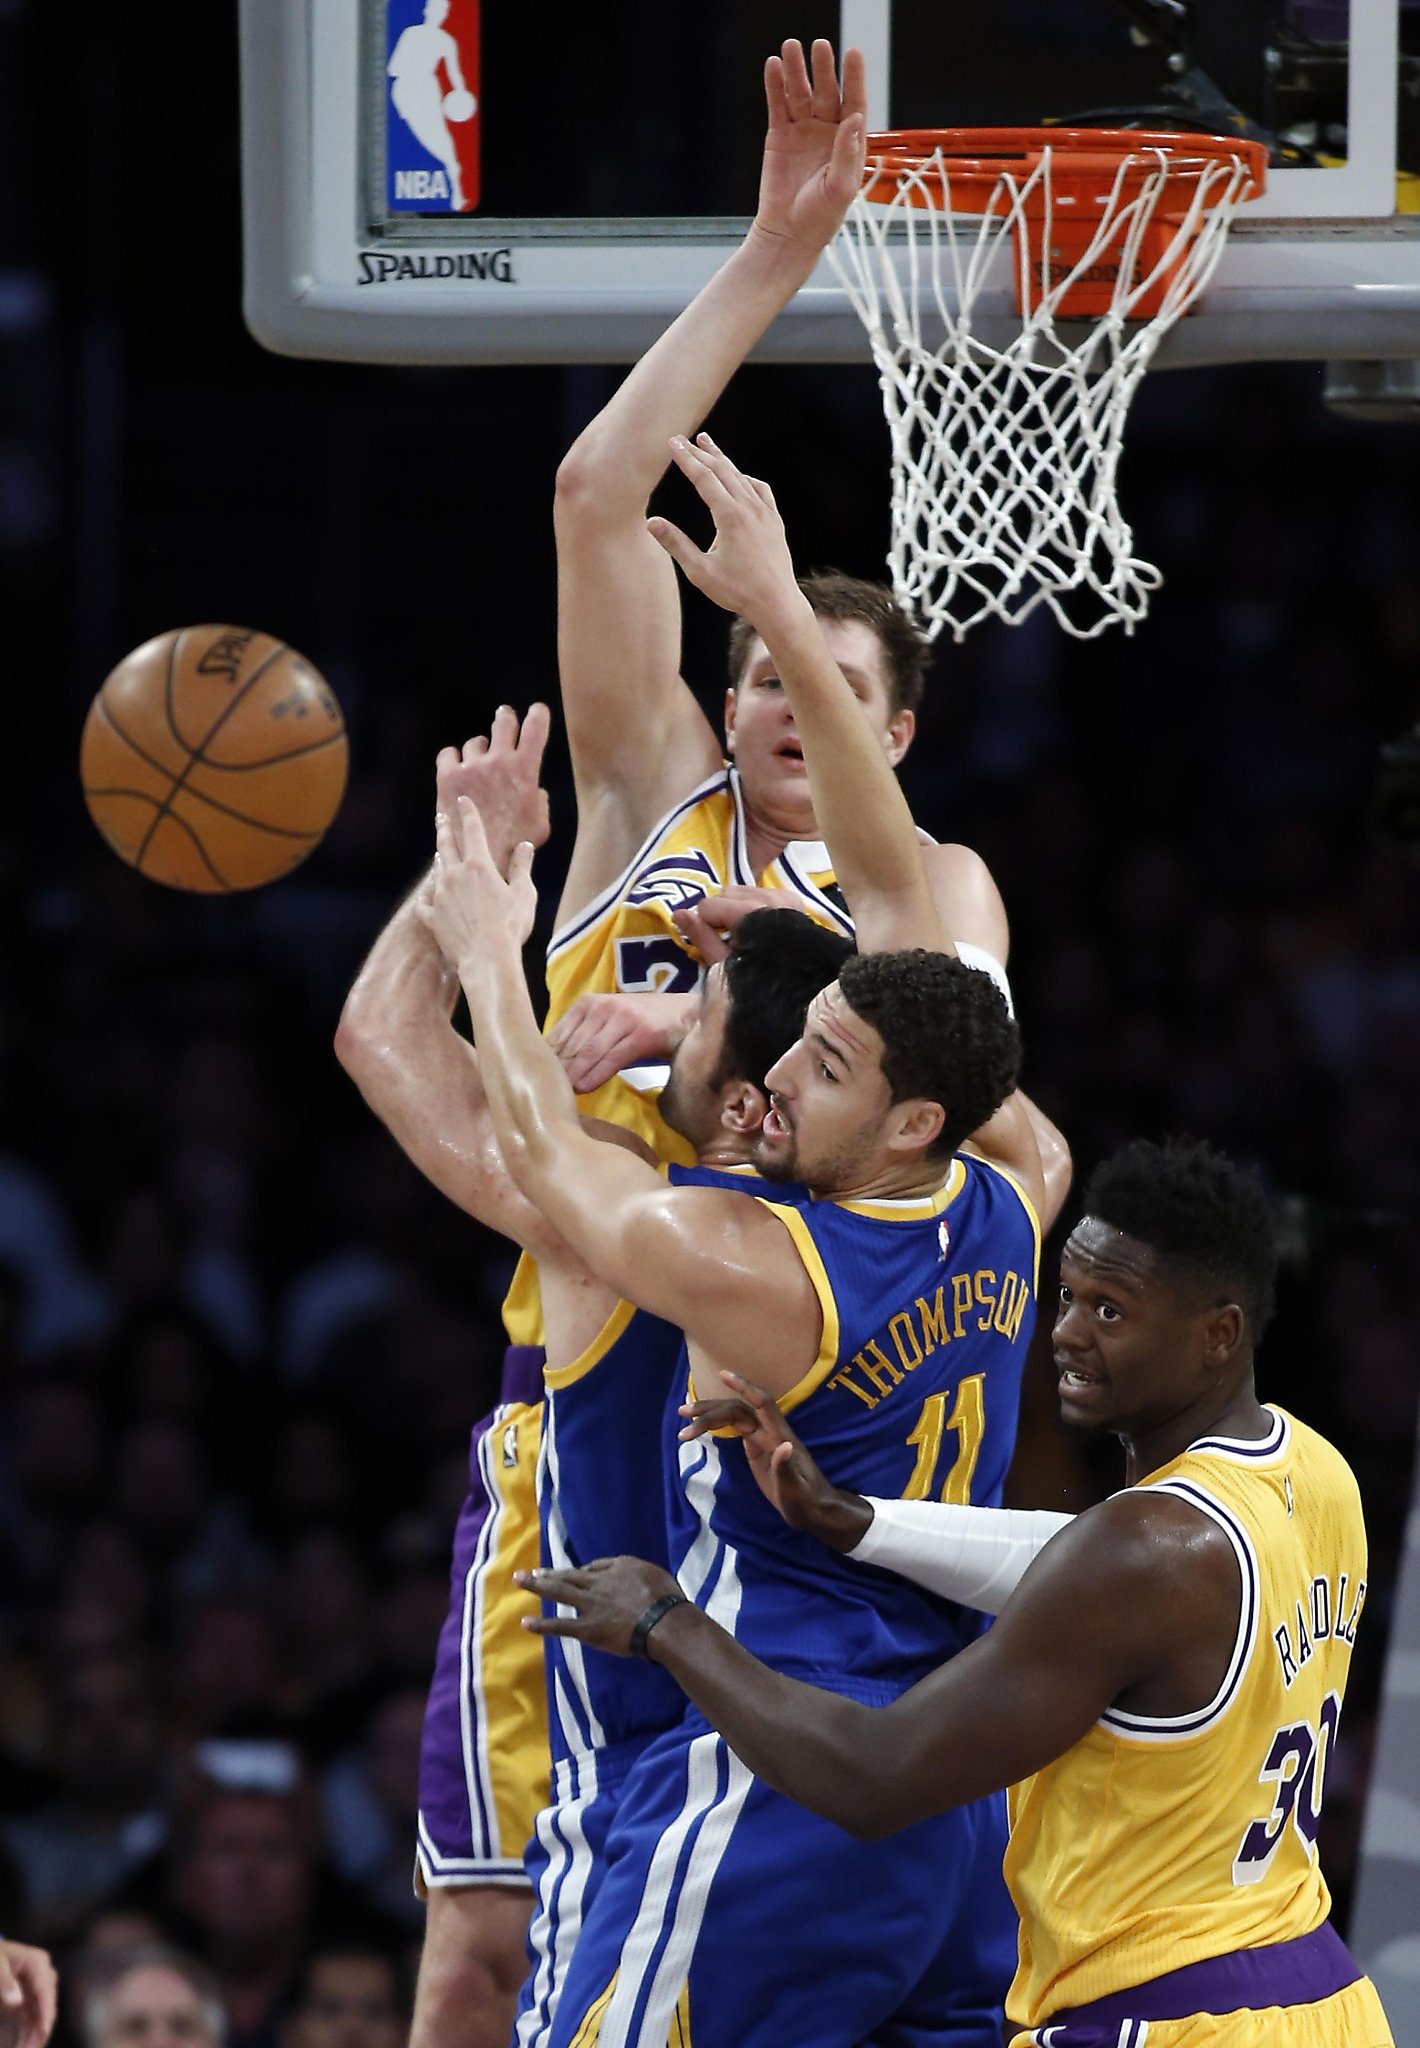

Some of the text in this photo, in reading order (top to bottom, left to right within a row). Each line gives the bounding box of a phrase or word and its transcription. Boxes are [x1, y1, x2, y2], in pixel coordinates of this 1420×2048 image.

[395, 170, 450, 199] NBA
[357, 249, 516, 285] SPALDING
[826, 1269, 1030, 1410] THOMPSON
[901, 1372, 987, 1505] 11
[1273, 1573, 1367, 1690] RADLE
[1231, 1688, 1343, 1887] 30
